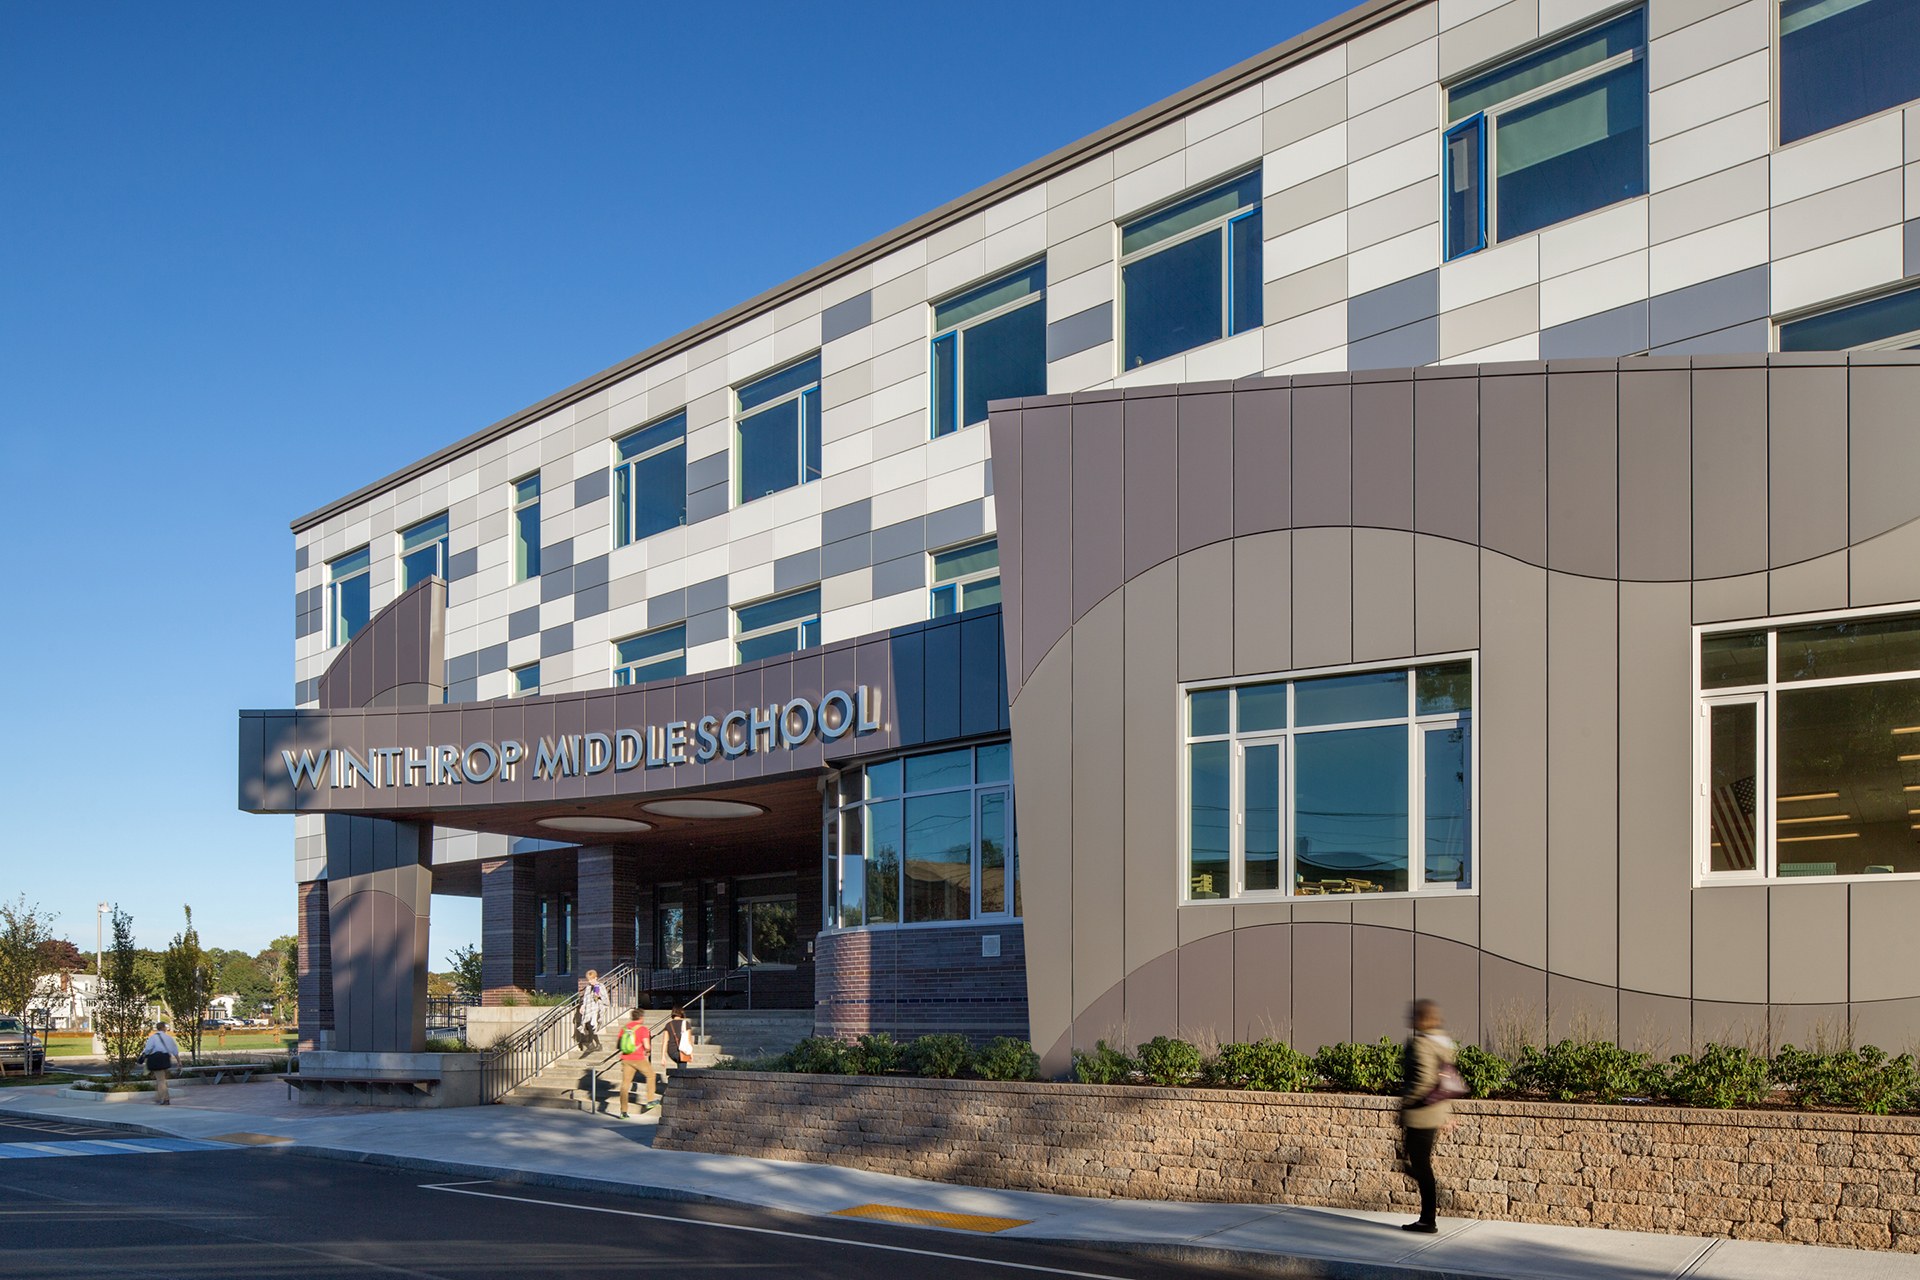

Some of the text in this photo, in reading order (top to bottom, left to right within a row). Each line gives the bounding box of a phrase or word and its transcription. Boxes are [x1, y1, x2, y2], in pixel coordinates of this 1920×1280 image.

[282, 685, 880, 790] WINTHROP MIDDLE SCHOOL
